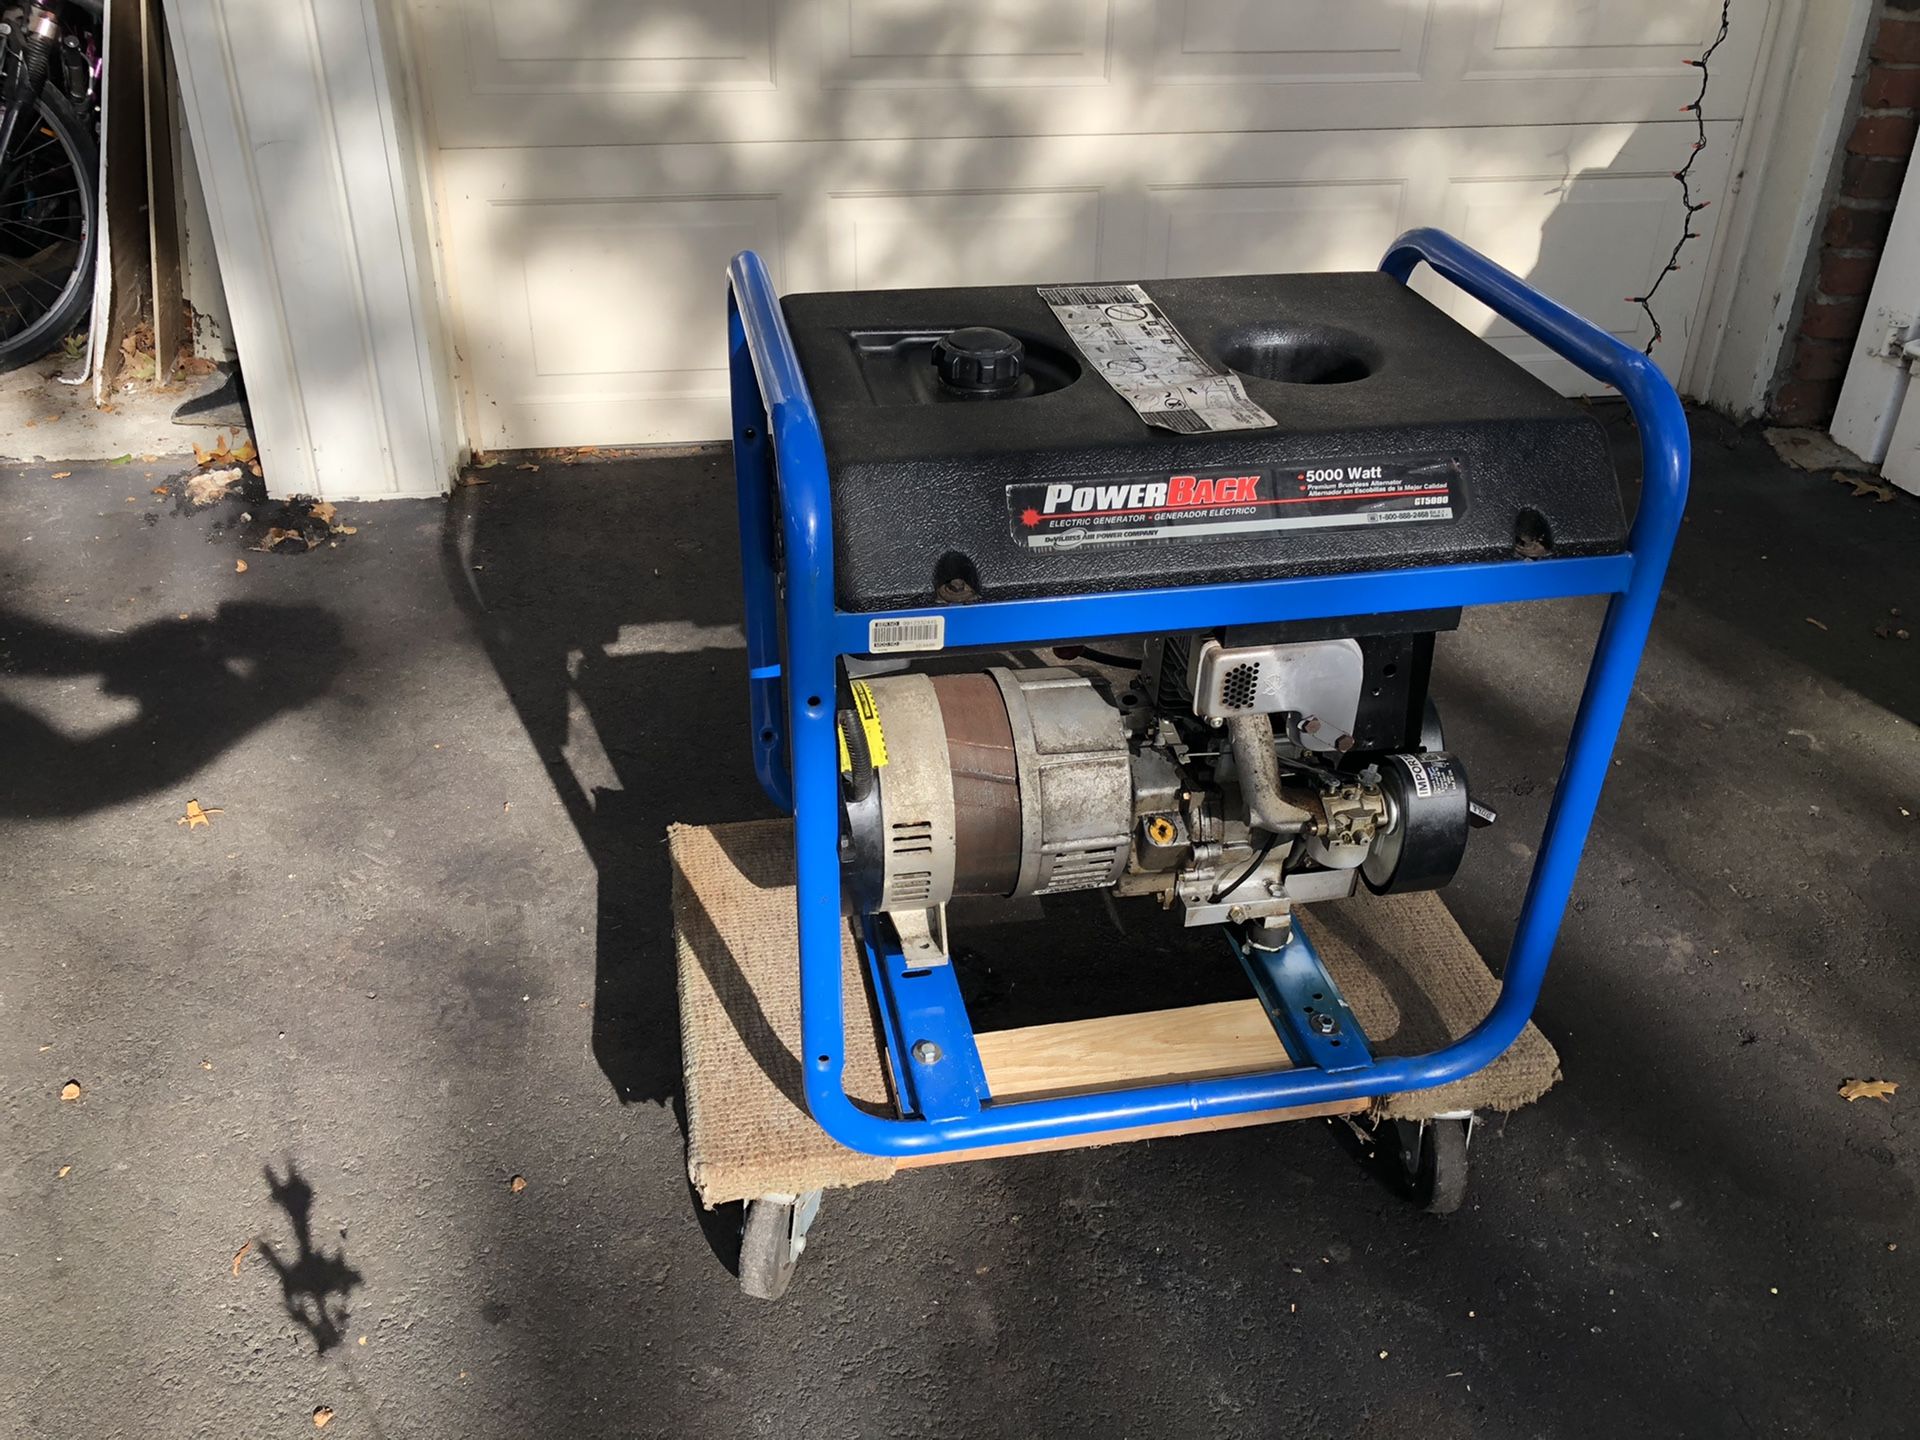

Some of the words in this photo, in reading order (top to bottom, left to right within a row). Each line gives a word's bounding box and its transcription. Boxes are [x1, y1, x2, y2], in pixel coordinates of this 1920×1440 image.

[1306, 469, 1344, 482] 5000
[1347, 466, 1382, 481] Watt
[1307, 483, 1337, 491] Premium
[1338, 481, 1369, 489] Brushless
[1371, 479, 1403, 487] Alternator
[1308, 489, 1343, 497] Alternador
[1354, 487, 1387, 495] Escobillas
[1405, 484, 1423, 492] Mejor
[1424, 482, 1448, 490] Calidad
[1049, 517, 1091, 528] ELECTRIC
[1093, 514, 1146, 525] GENERATOR
[1154, 510, 1208, 521] GENERADOR
[1082, 533, 1095, 541] AIR
[1124, 530, 1159, 538] COMPANY
